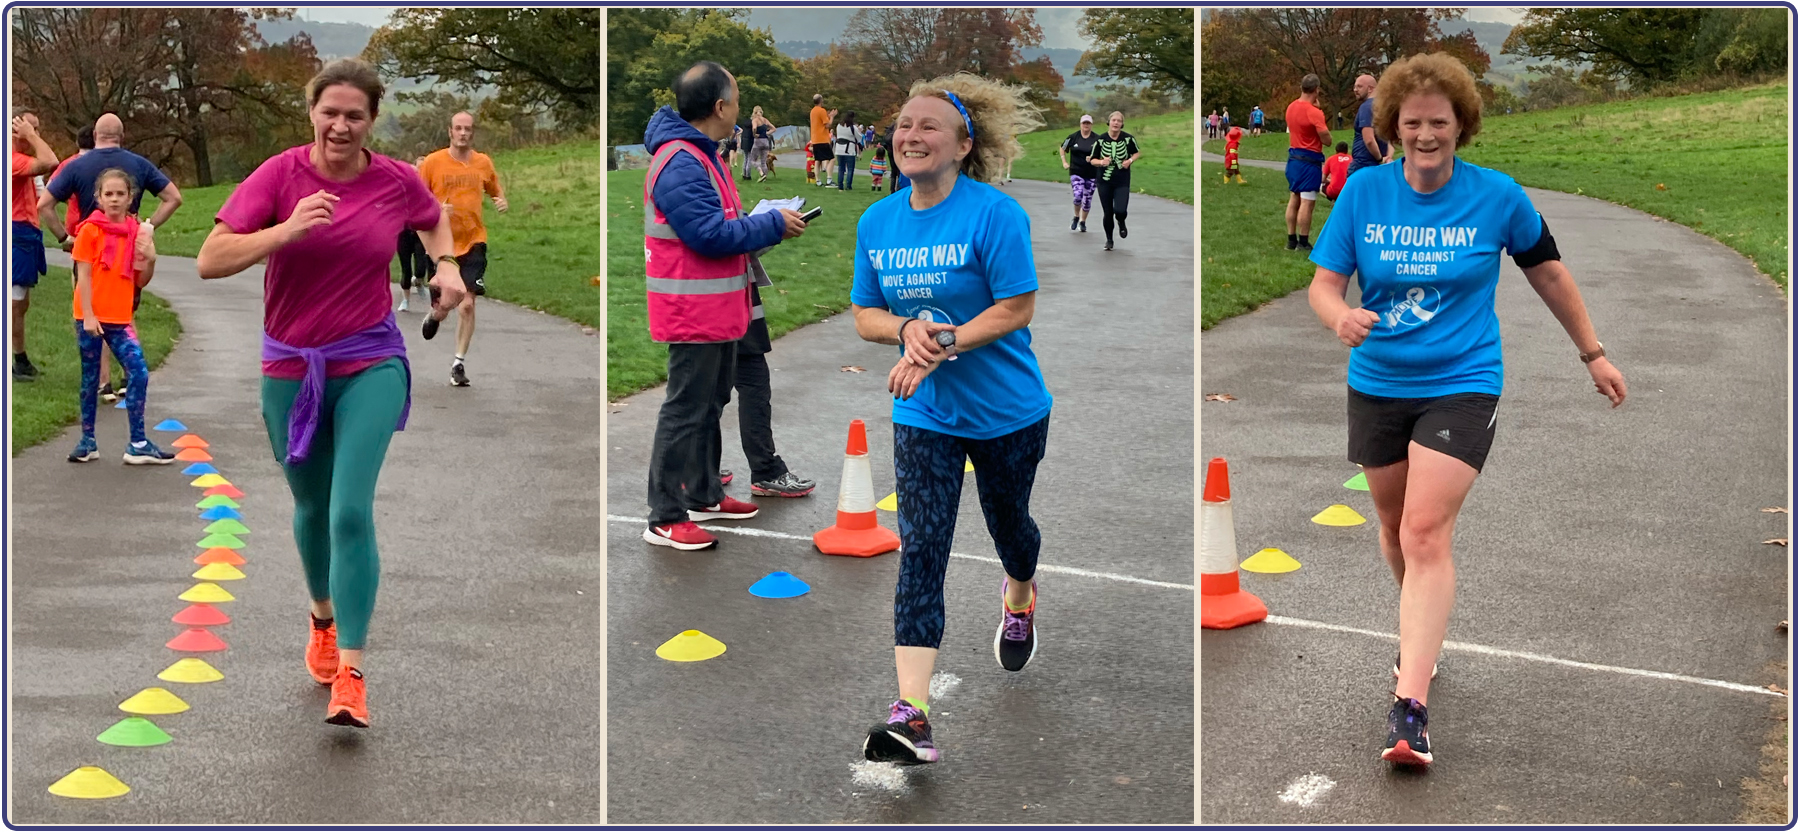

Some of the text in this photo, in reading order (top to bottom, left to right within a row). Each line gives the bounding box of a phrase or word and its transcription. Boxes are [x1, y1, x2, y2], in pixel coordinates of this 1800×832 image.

[1364, 223, 1478, 247] 5K YOUR WAY
[888, 246, 929, 270] YOUR
[932, 243, 968, 267] WAY
[1380, 250, 1456, 263] MOVE AGAINST
[1396, 263, 1438, 276] CANCER
[882, 271, 948, 287] MOVE AGAINST
[896, 287, 934, 300] CANCER
[1391, 297, 1420, 322] MOVE
